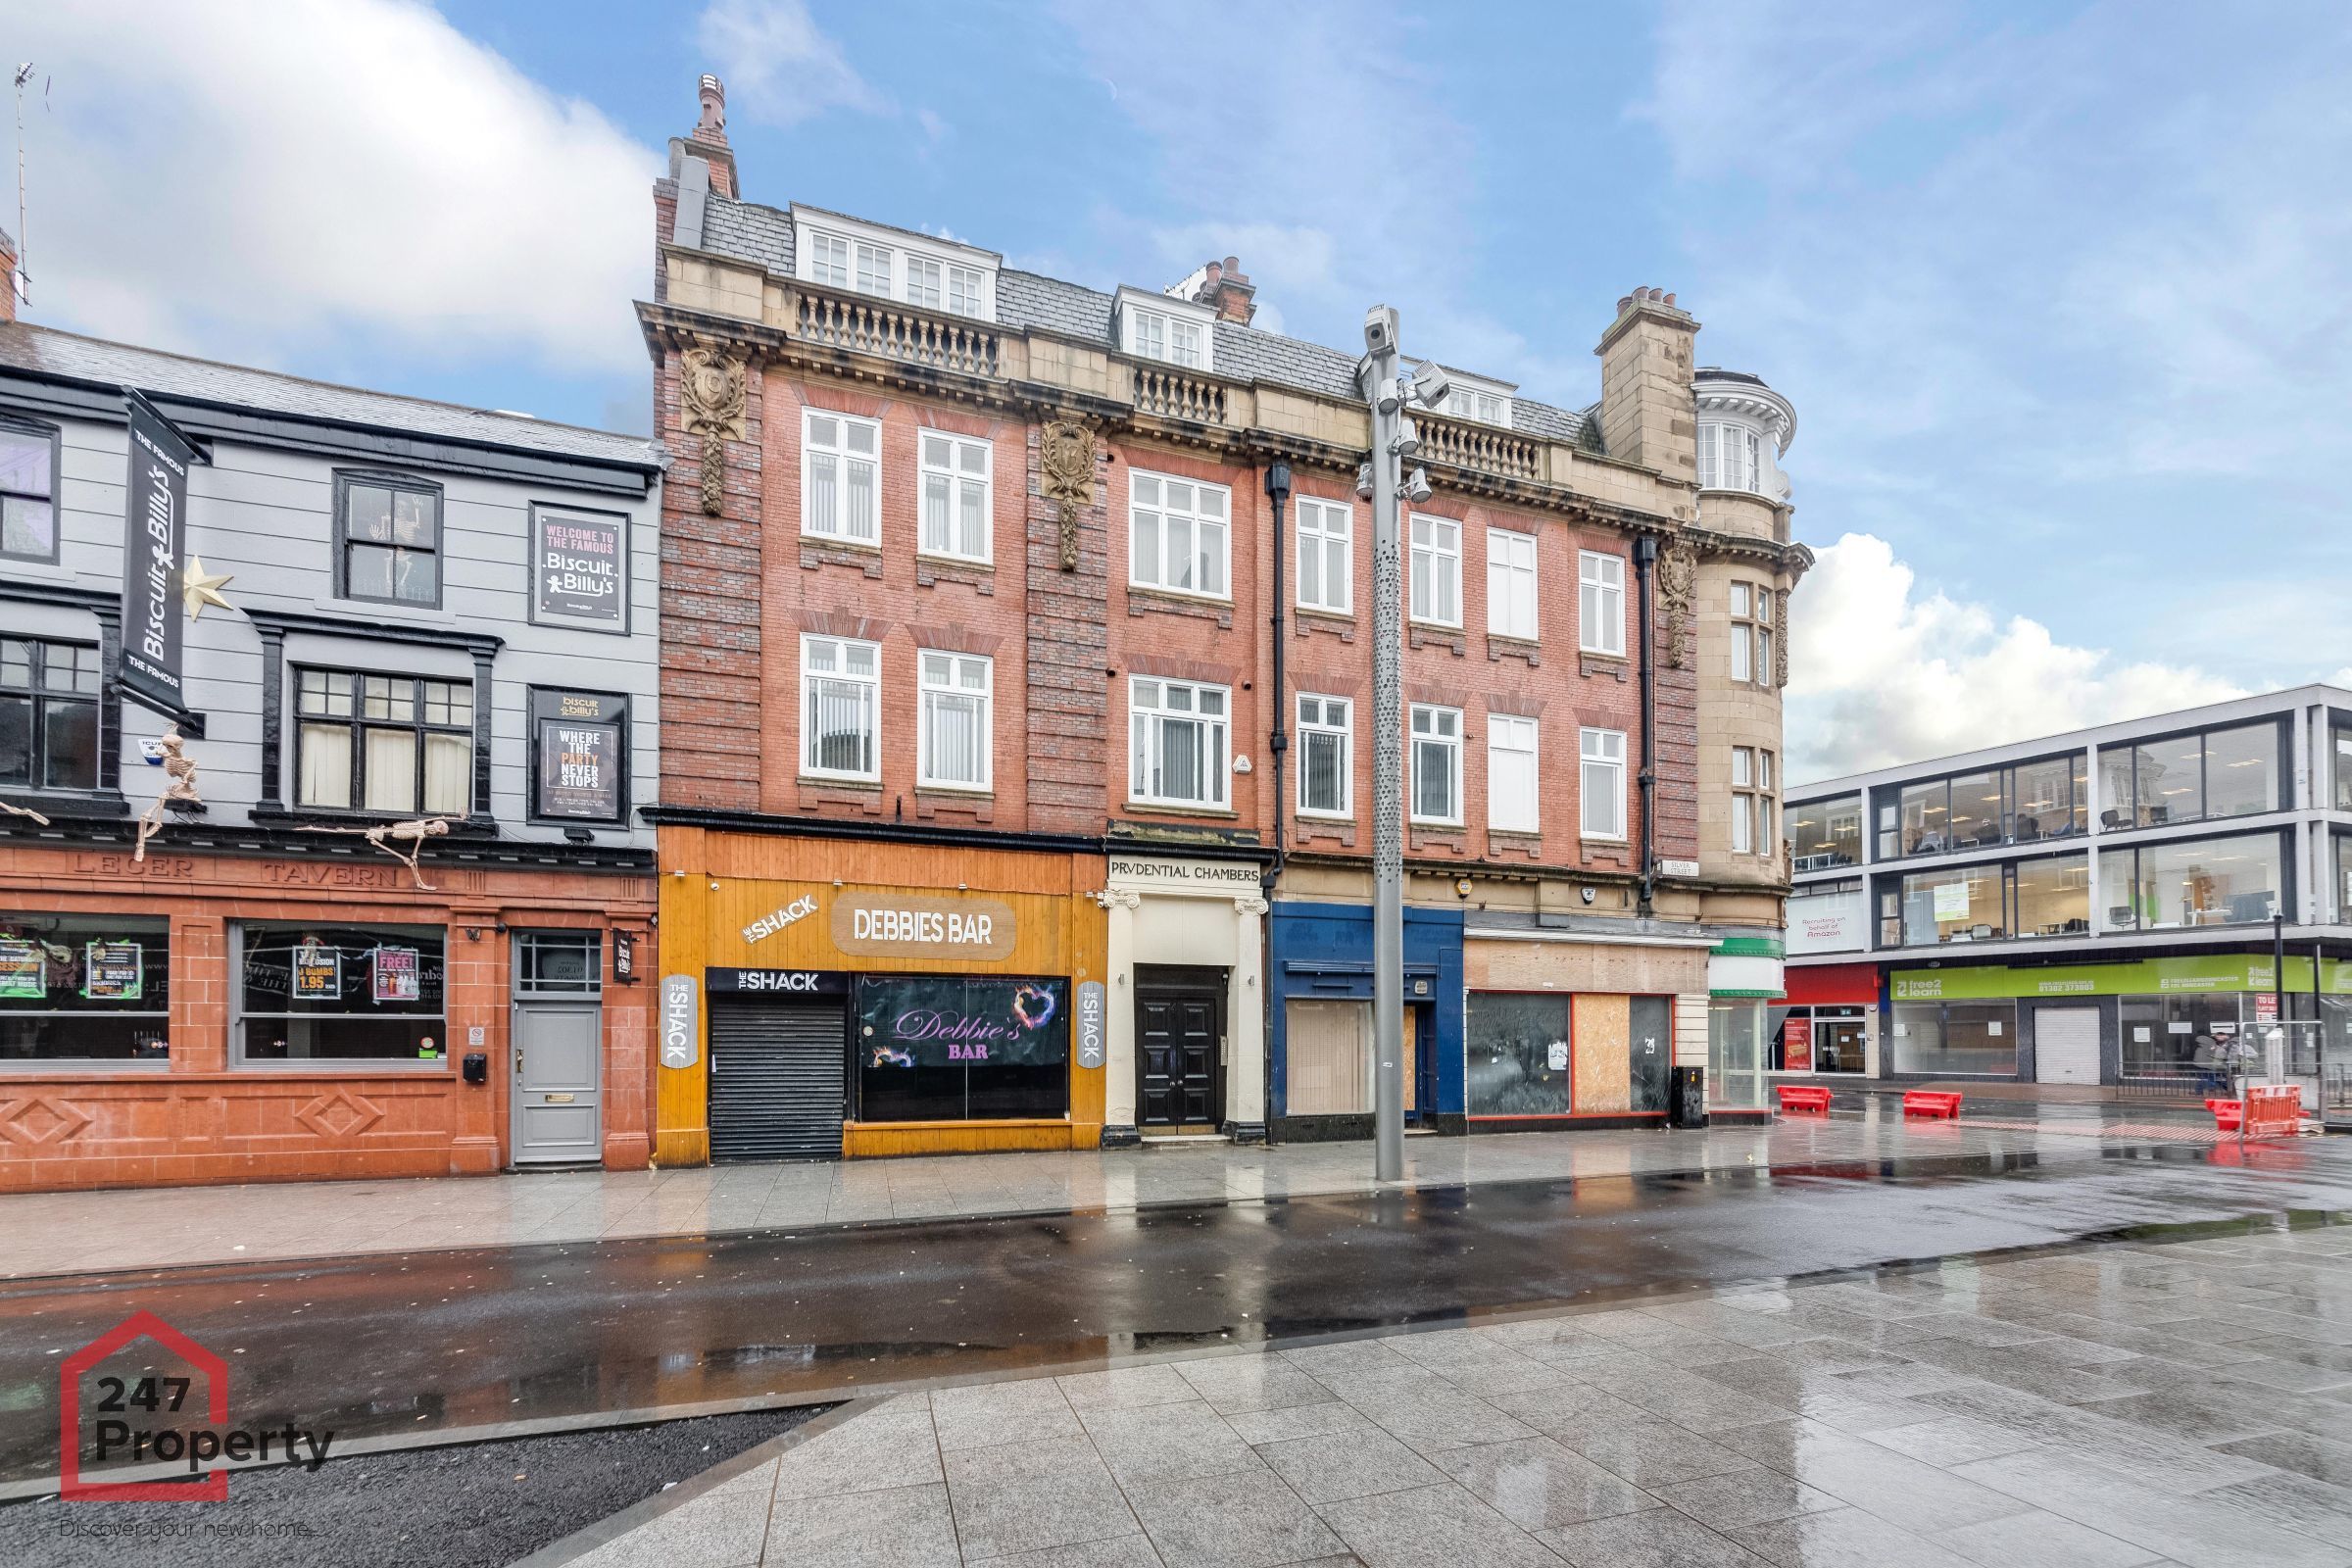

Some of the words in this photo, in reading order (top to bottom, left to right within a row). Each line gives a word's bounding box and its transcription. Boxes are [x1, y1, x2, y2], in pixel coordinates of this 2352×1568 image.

[134, 427, 152, 450] THE
[153, 444, 184, 476] FAMOUS
[148, 465, 174, 546] Billy's
[547, 525, 598, 542] WELCOME
[601, 532, 613, 544] TO
[547, 536, 567, 549] THE
[570, 539, 613, 555] FAMOUS
[564, 573, 613, 597] Billy's
[144, 564, 168, 662] Biscuit
[127, 654, 146, 671] THE
[147, 664, 179, 688] FAMOUS
[559, 730, 601, 745] WHERE
[568, 743, 591, 755] THE
[561, 753, 599, 766] PARTY
[561, 764, 599, 777] NEVER
[561, 775, 599, 788] STOPS
[265, 864, 397, 886] TAVERN
[1195, 867, 1259, 882] CHAMBERS
[743, 927, 757, 944] THE
[751, 894, 818, 939] SHACK
[854, 908, 944, 943] DEBBIES
[948, 913, 993, 945] BAR
[305, 966, 333, 976] BOMBS
[379, 956, 414, 969] FREE!
[300, 976, 323, 989] 1.95
[738, 971, 747, 988] THE
[748, 972, 818, 991] SHACK
[1910, 979, 1941, 989] free2
[2258, 996, 2267, 1004] TO
[667, 992, 688, 1058] SHACK
[893, 1009, 1020, 1041] Debbie's
[1083, 1000, 1099, 1058] SHACK
[948, 1045, 989, 1059] BAR
